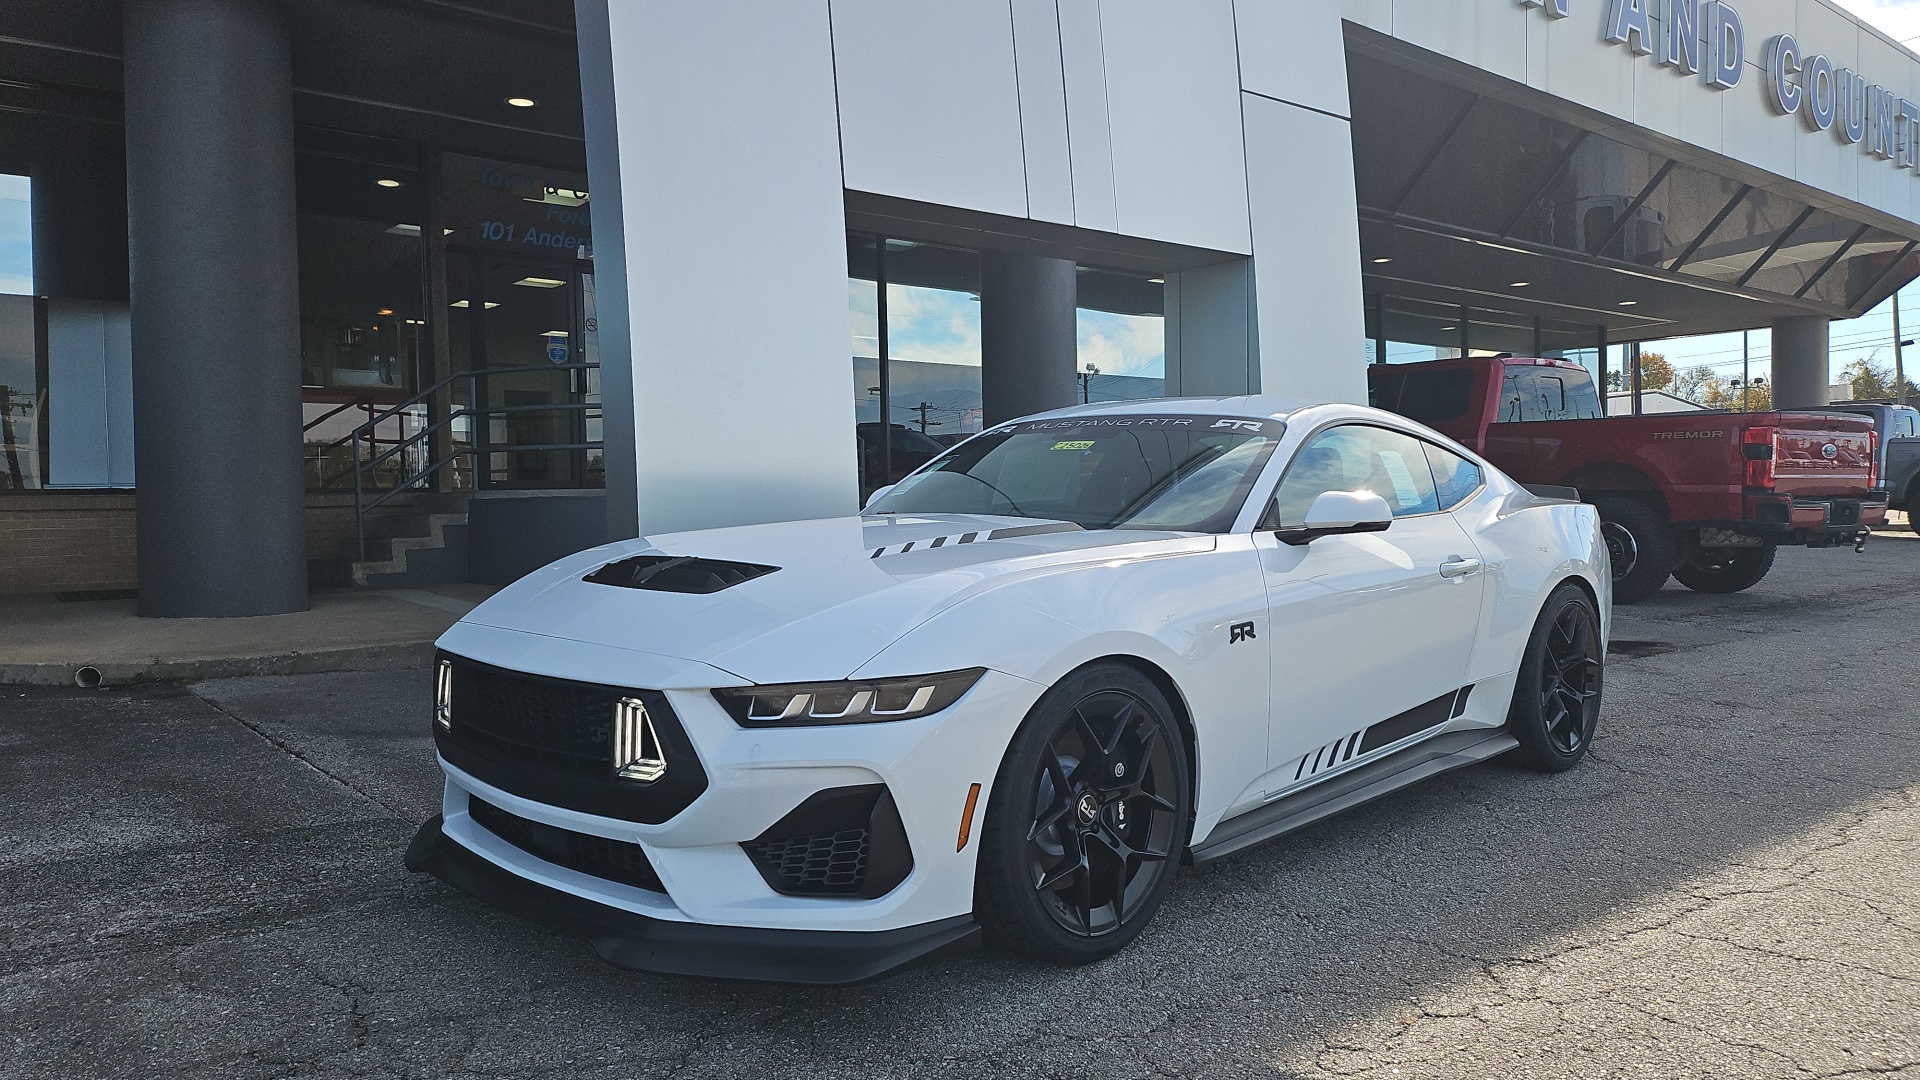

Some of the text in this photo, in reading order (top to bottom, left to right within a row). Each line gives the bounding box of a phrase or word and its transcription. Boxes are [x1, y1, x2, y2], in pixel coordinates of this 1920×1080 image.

[1767, 33, 1920, 168] COUNT
[480, 220, 515, 242] 101
[1026, 418, 1193, 430] MUSTANG RTR
[1650, 430, 1724, 440] TREMOR
